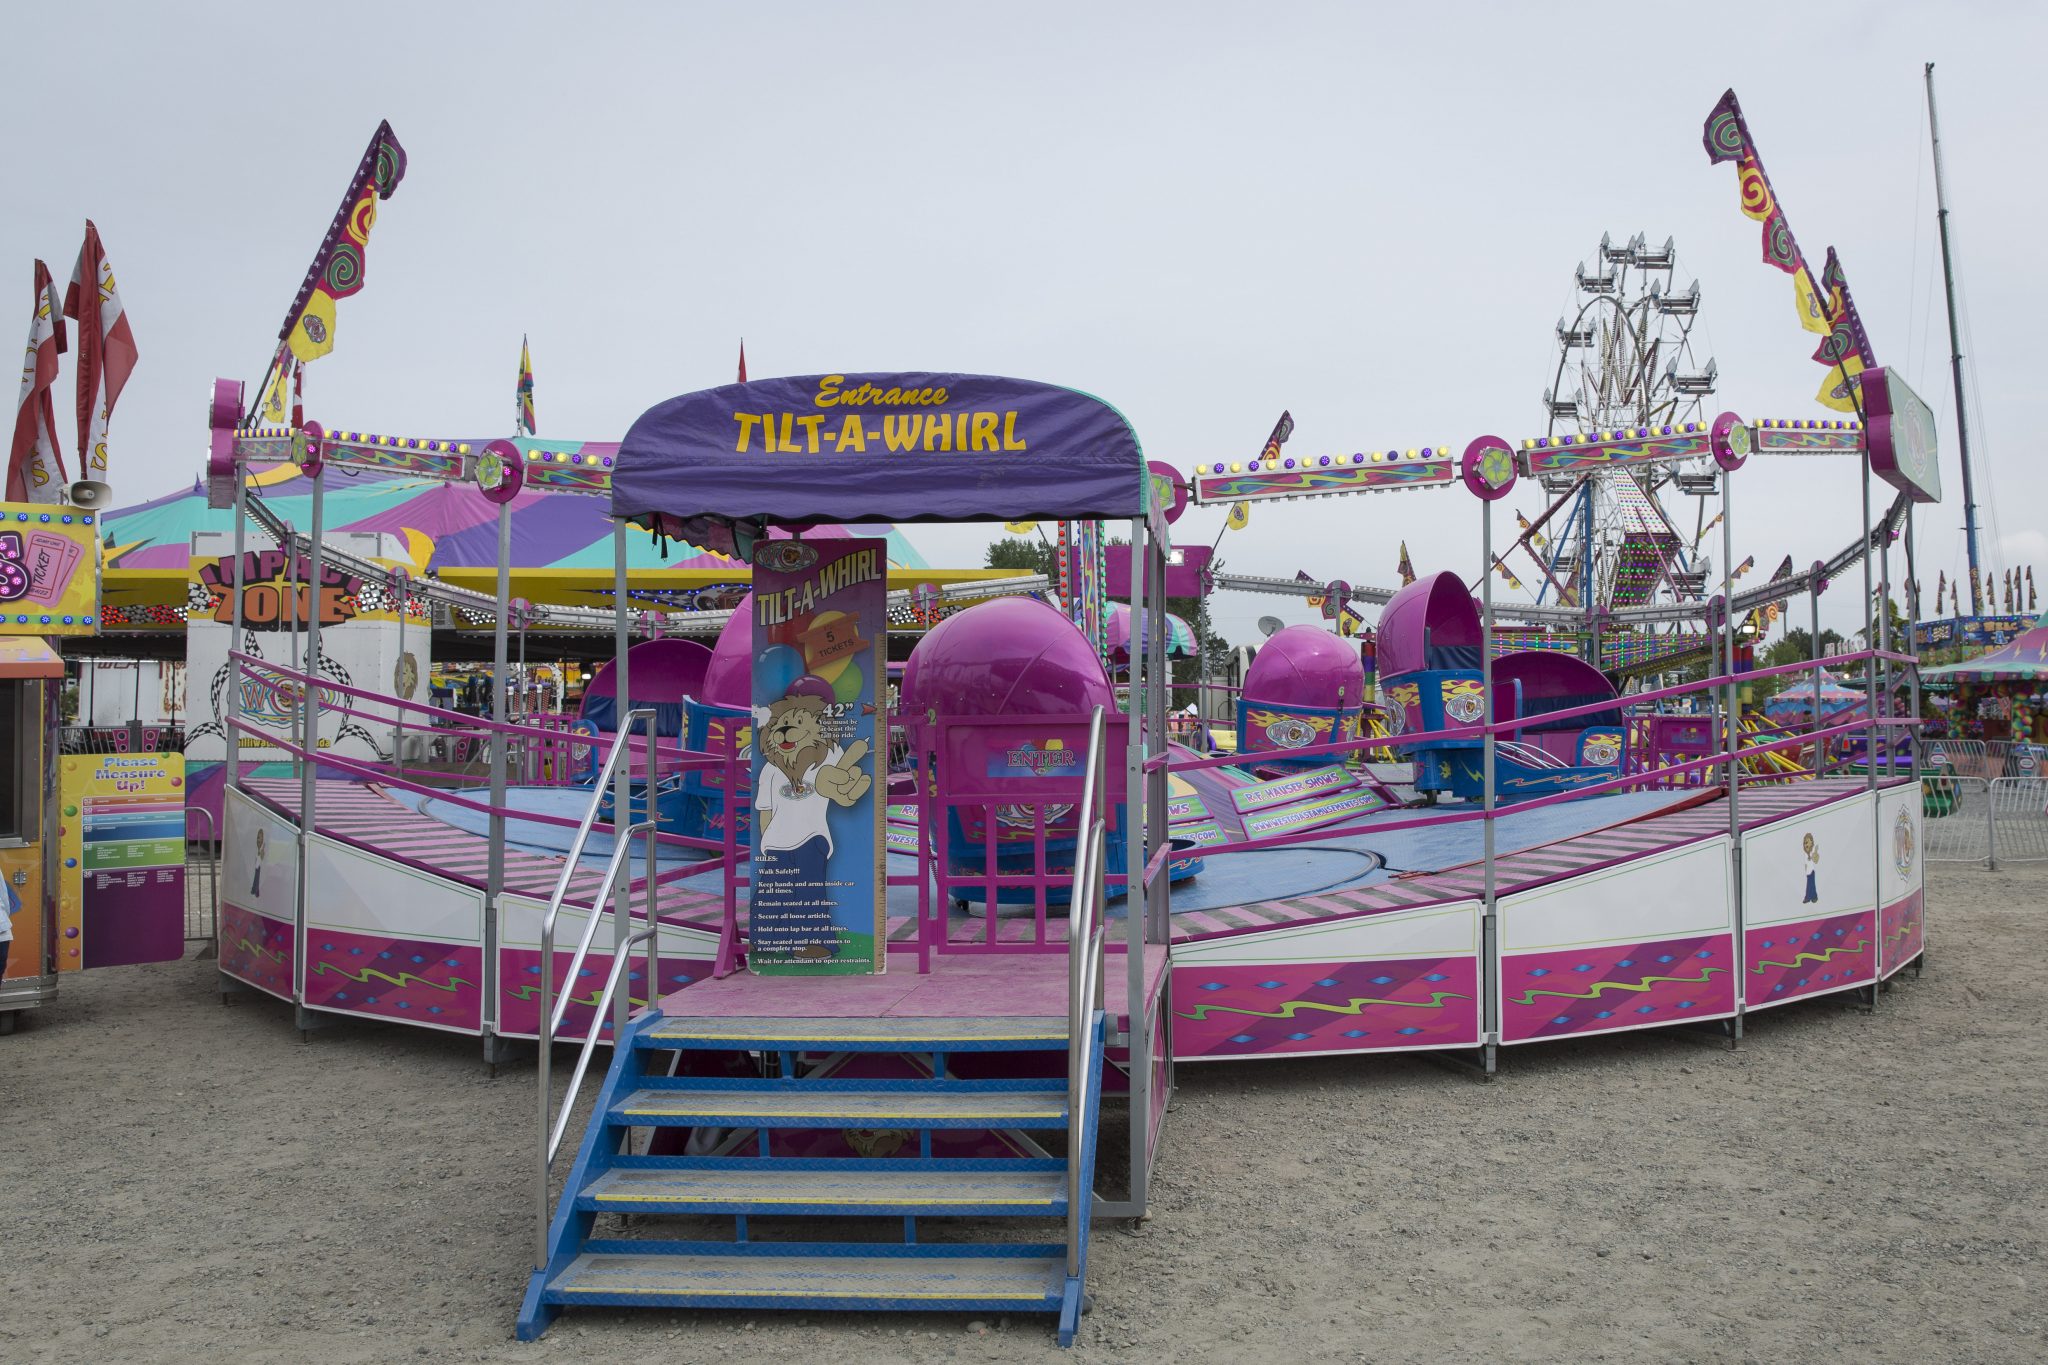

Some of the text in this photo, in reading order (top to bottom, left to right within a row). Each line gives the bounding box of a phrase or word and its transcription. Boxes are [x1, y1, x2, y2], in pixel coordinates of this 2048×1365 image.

[814, 375, 949, 408] Entrance
[733, 411, 1027, 454] TILT-A-WHIRL
[33, 548, 52, 585] TICKET
[757, 548, 882, 627] TILT-A-WHIRL
[208, 584, 352, 624] ZONE
[825, 631, 835, 643] 5
[818, 639, 855, 658] TICKETS
[103, 757, 158, 768] Please
[1007, 750, 1076, 767] ENTER
[95, 769, 166, 780] Measure
[116, 780, 145, 792] Up!
[1265, 781, 1305, 799] HAUSER
[1305, 772, 1341, 789] SHOWS
[763, 945, 791, 953] complete
[792, 945, 808, 953] stop.
